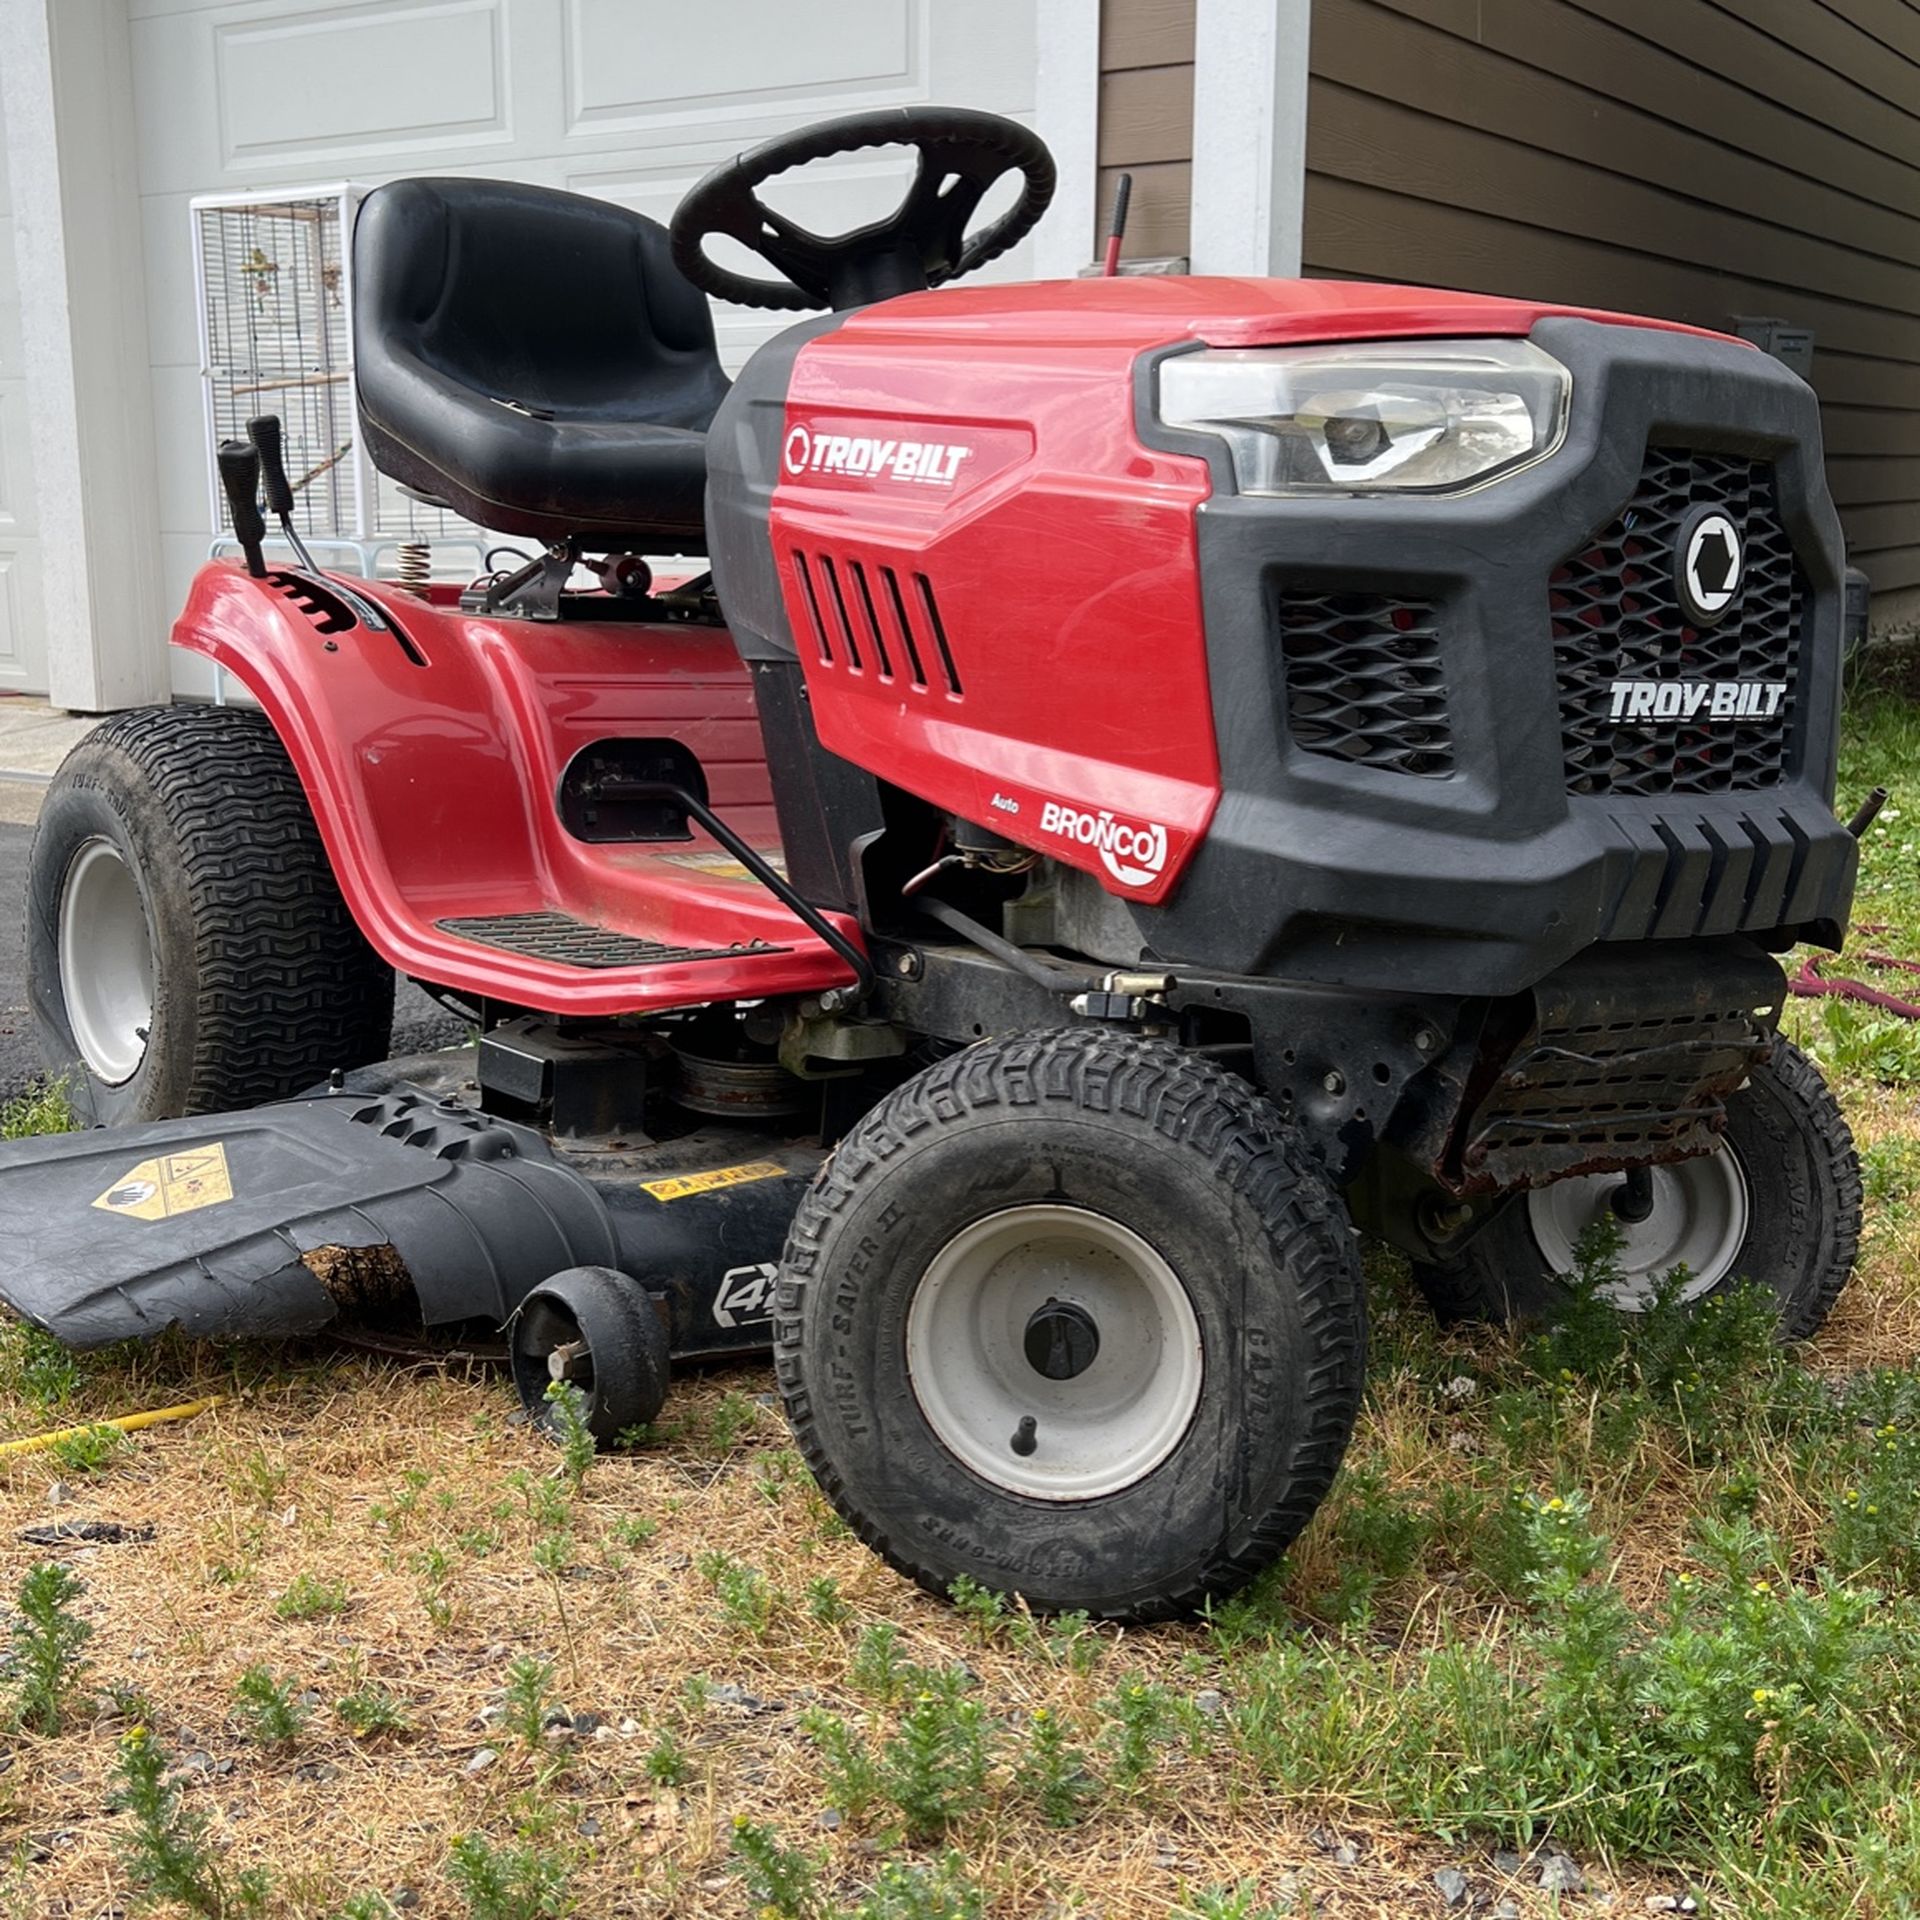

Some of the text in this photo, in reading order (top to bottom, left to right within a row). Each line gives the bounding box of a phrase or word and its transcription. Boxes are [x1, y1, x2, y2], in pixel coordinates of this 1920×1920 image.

[810, 435, 968, 485] TROY-BILT
[1609, 682, 1787, 722] TROY-BILT
[990, 793, 1020, 815] Auto
[1040, 802, 1155, 863] BRONCO
